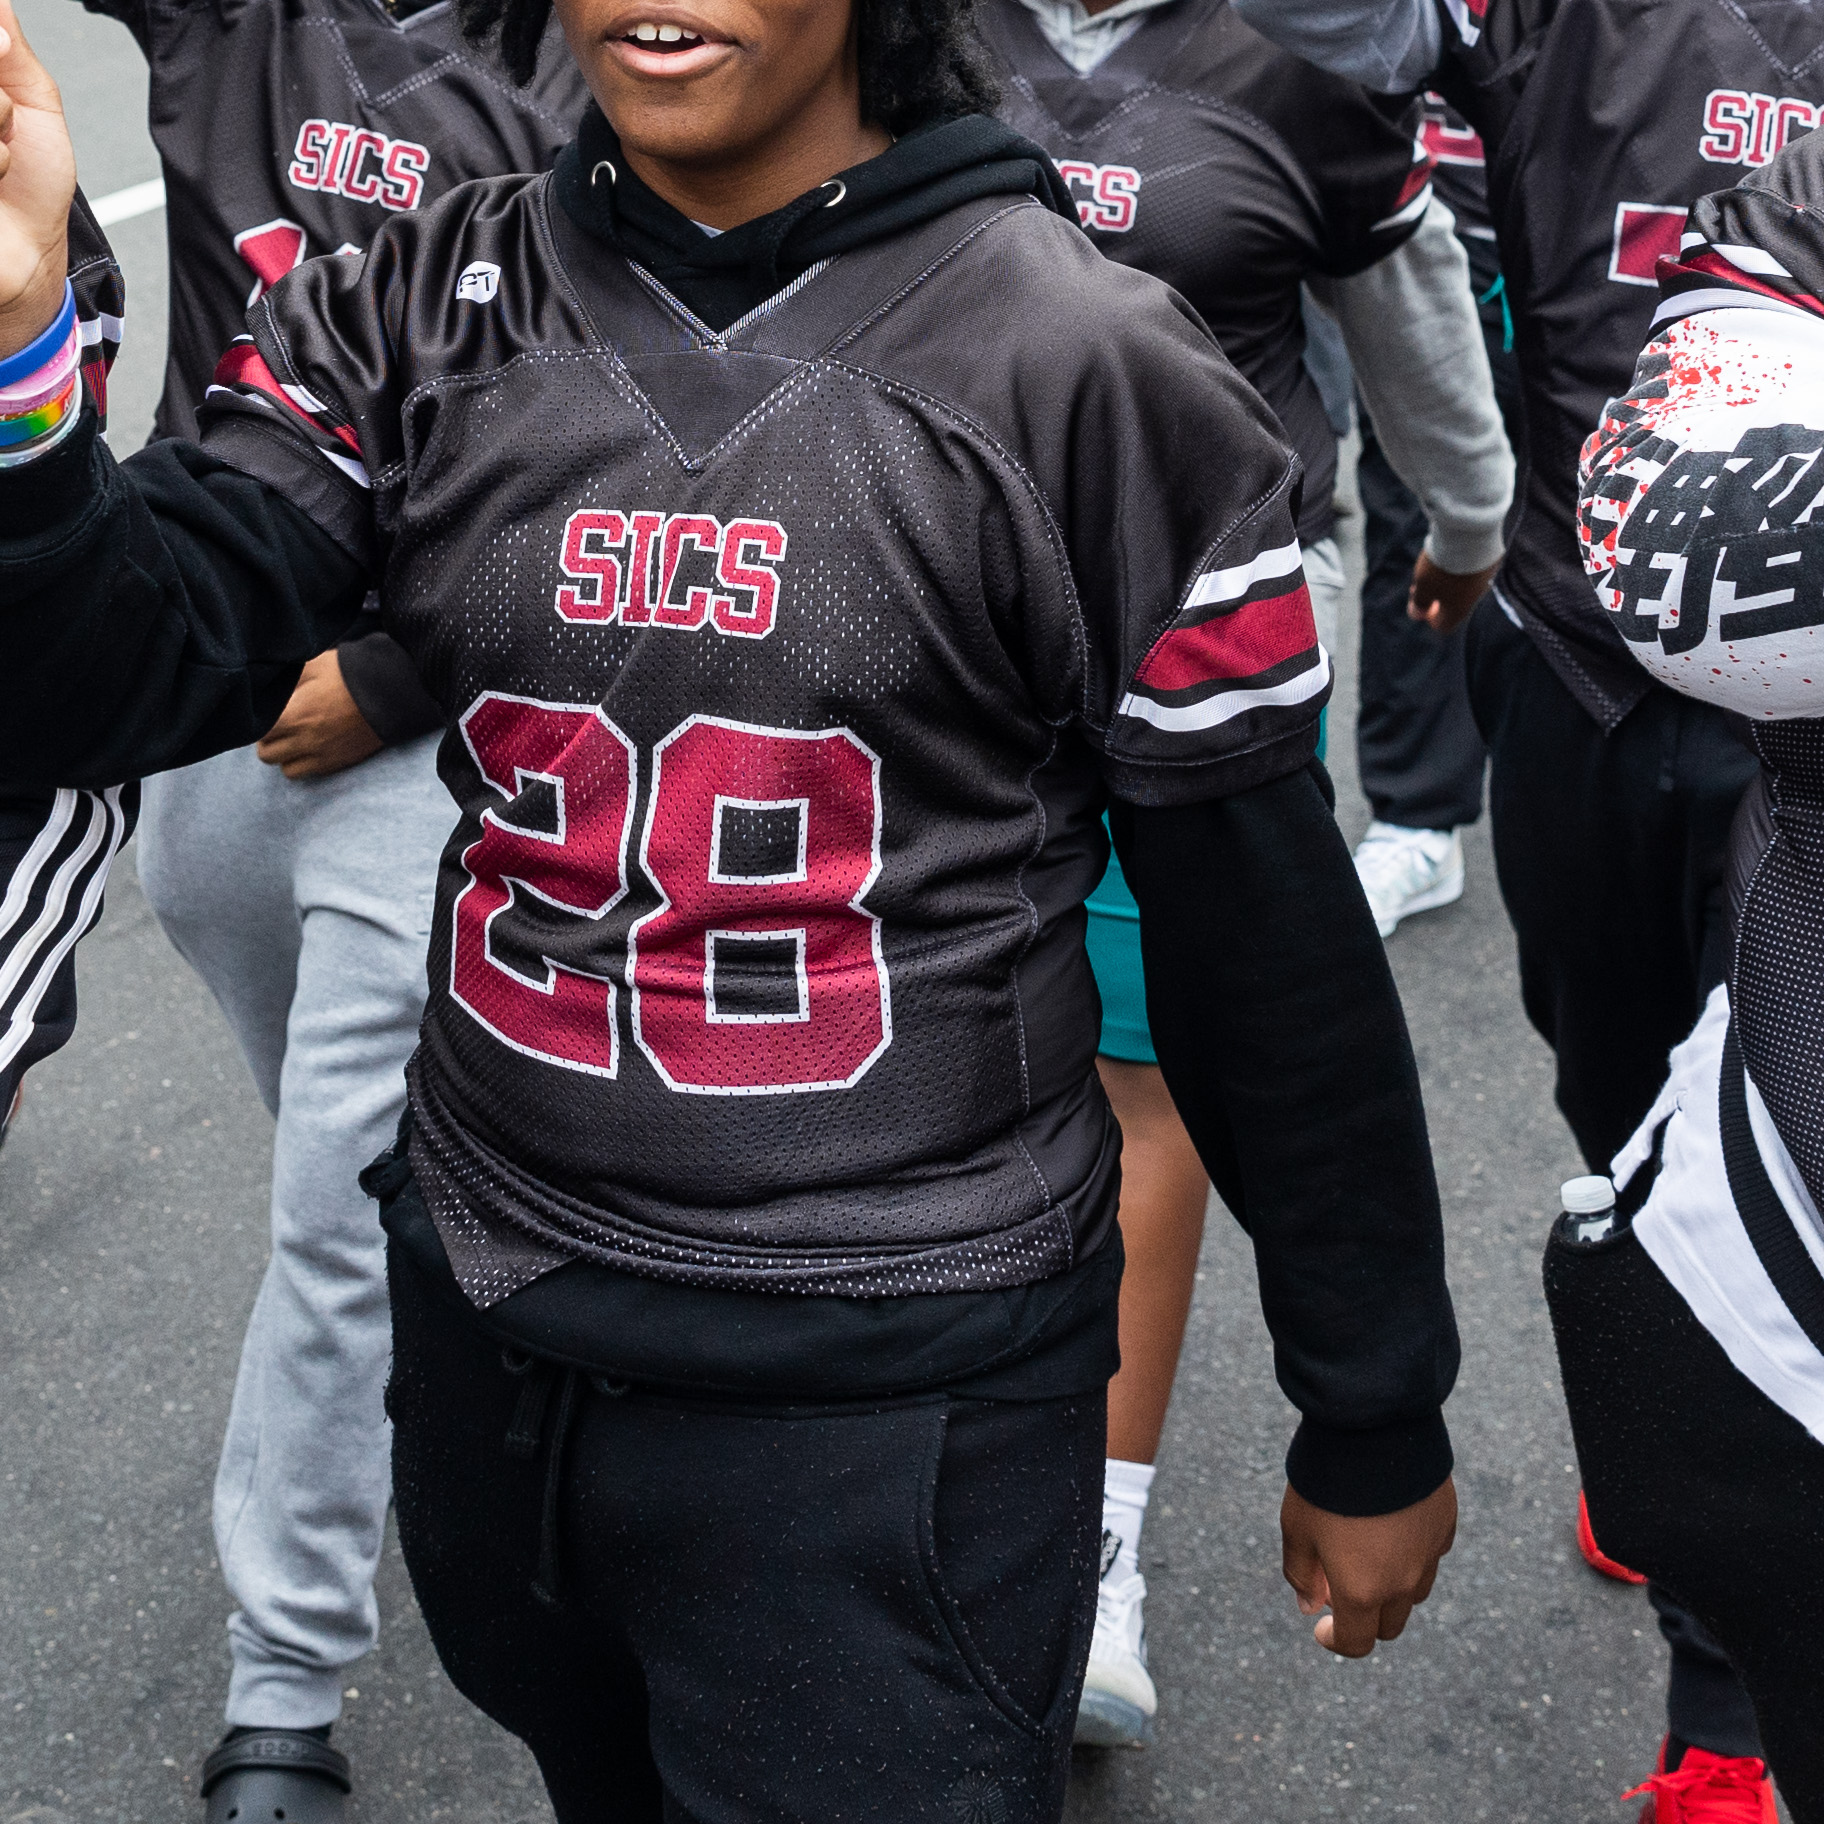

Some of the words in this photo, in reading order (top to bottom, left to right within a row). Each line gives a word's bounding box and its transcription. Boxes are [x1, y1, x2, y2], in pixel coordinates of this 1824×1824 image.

[288, 118, 431, 211] SICS
[1053, 159, 1141, 232] CS
[554, 507, 789, 639] SICS
[449, 690, 893, 1095] 28
